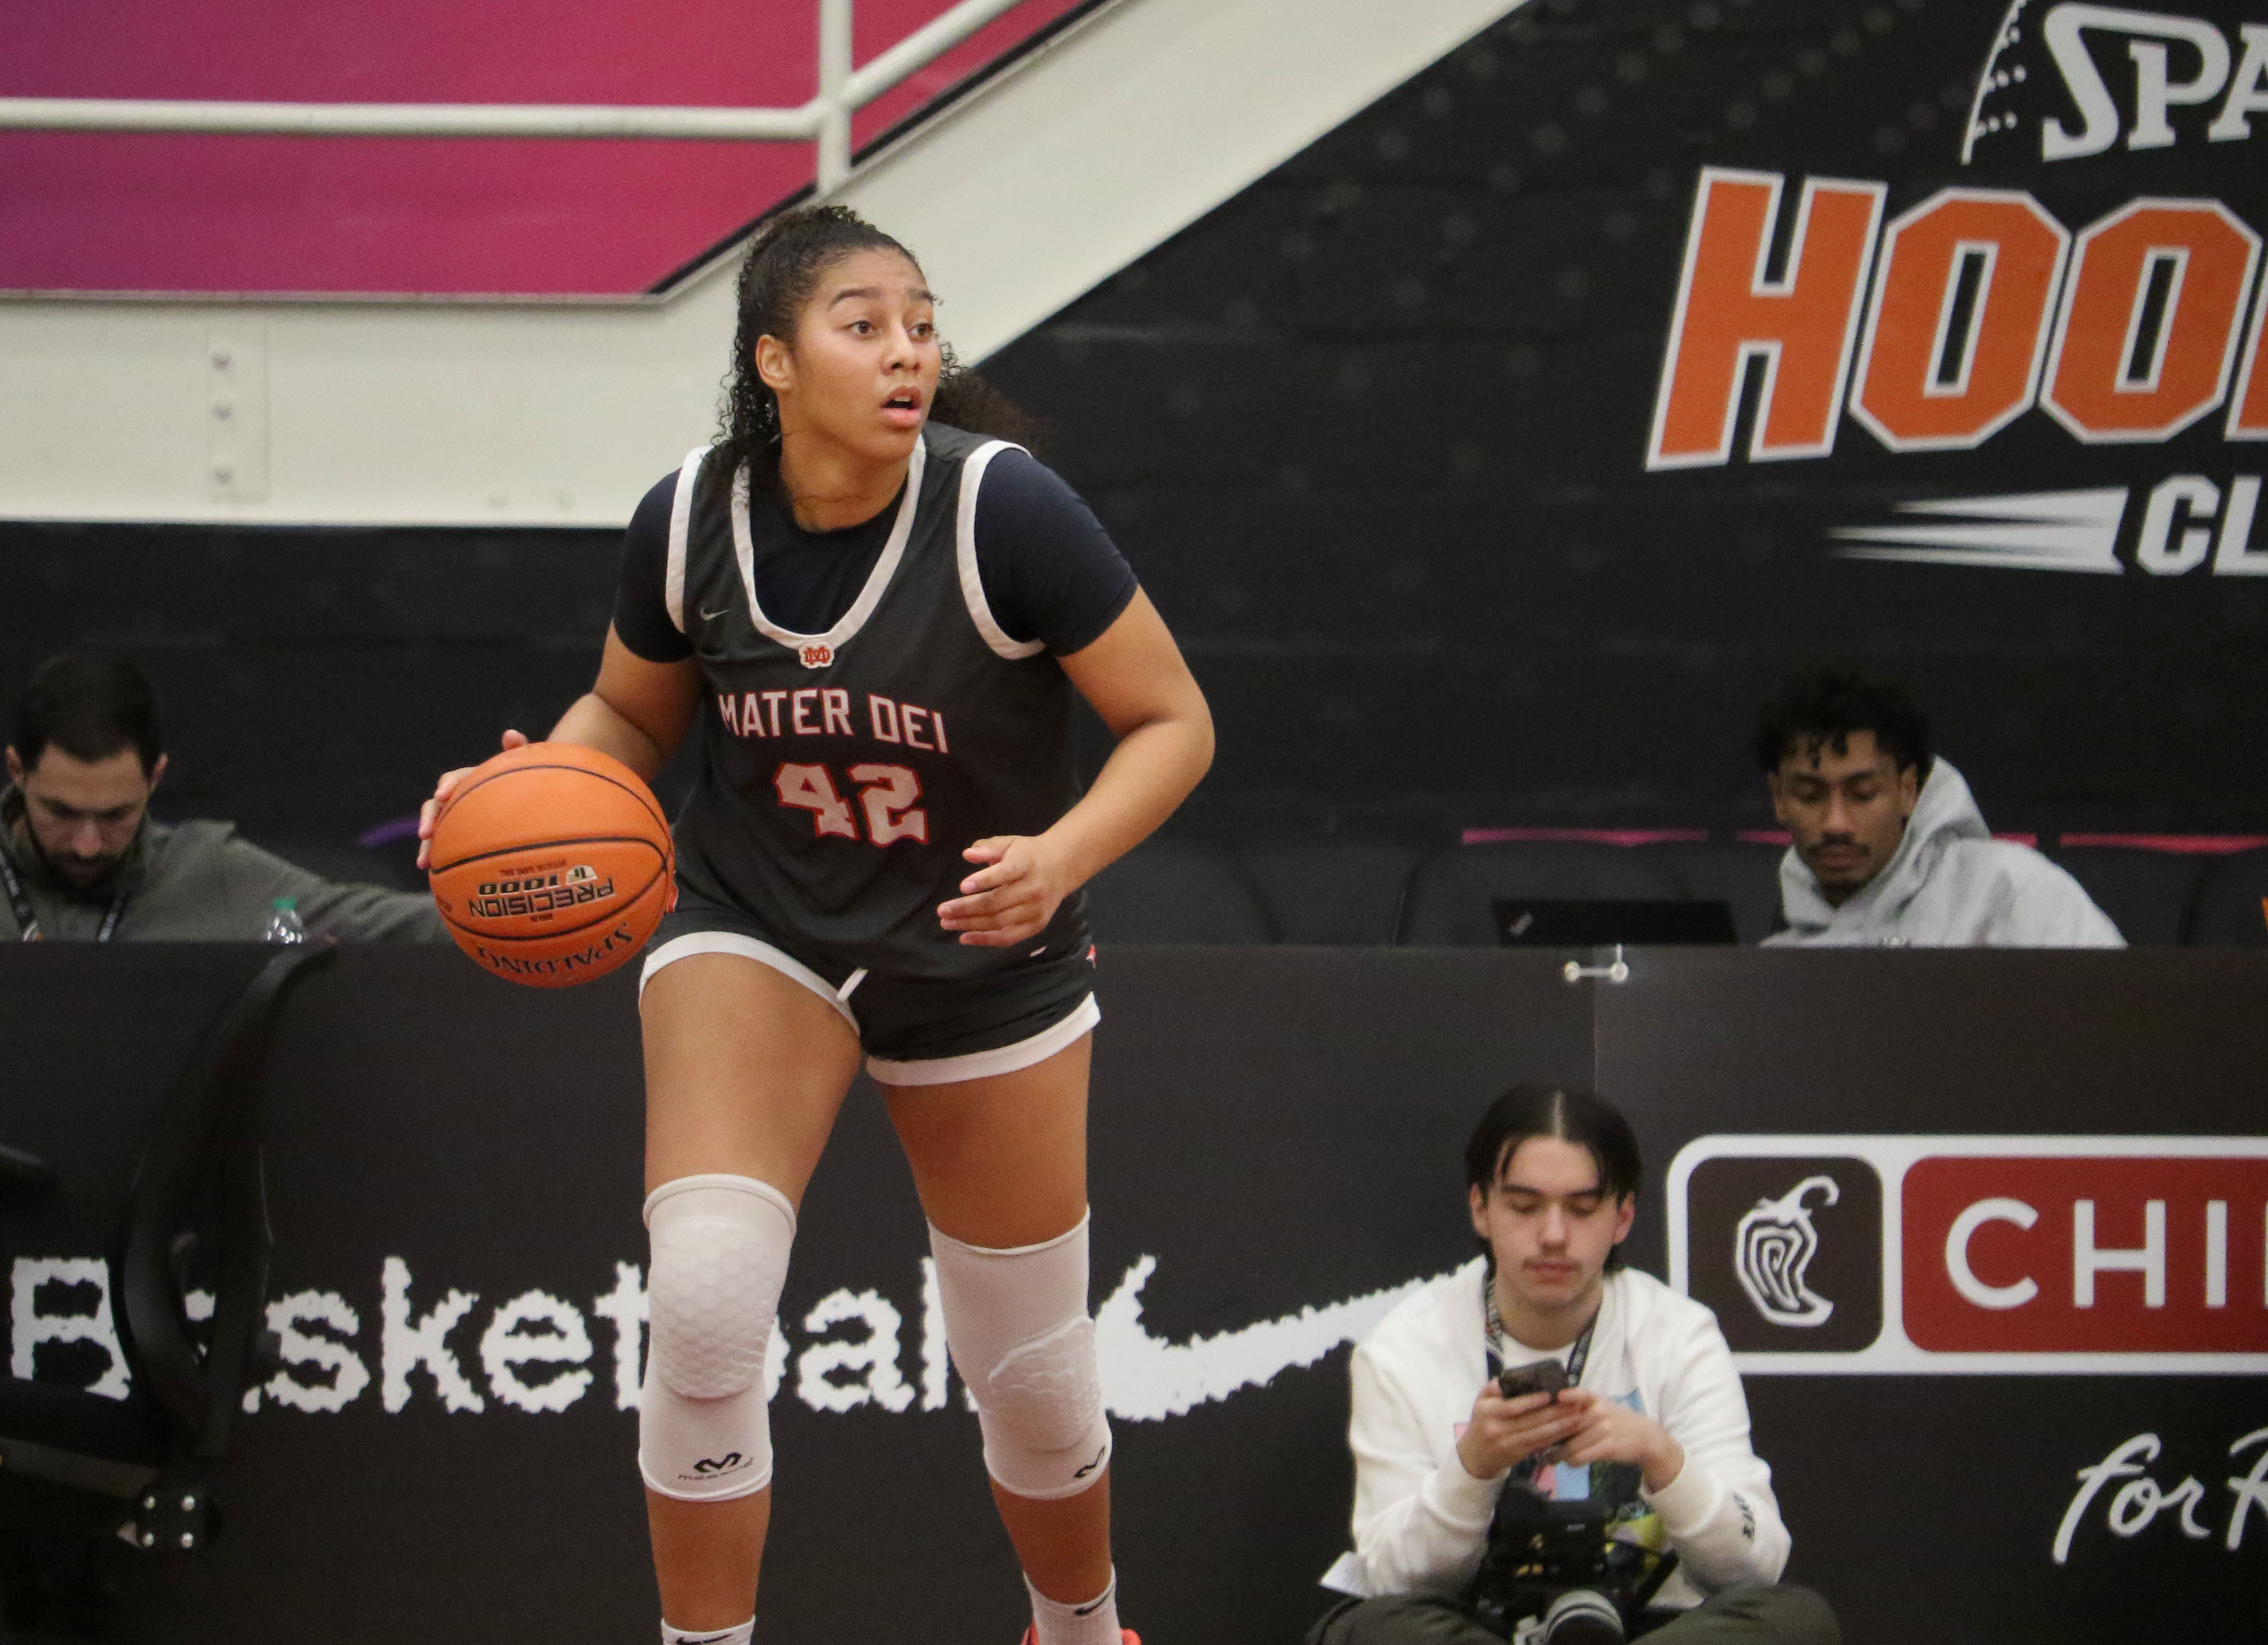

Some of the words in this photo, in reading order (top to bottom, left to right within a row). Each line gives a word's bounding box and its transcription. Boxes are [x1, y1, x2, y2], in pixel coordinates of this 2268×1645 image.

[1645, 165, 2268, 472] HOO
[717, 688, 854, 738] MATER
[867, 693, 949, 753] DEI
[773, 762, 929, 848] 42
[467, 877, 615, 918] PRECISION
[478, 873, 560, 897] 1000
[477, 922, 632, 973] SPALDING
[1945, 1197, 2268, 1309] CHI
[2053, 1433, 2210, 1564] for
